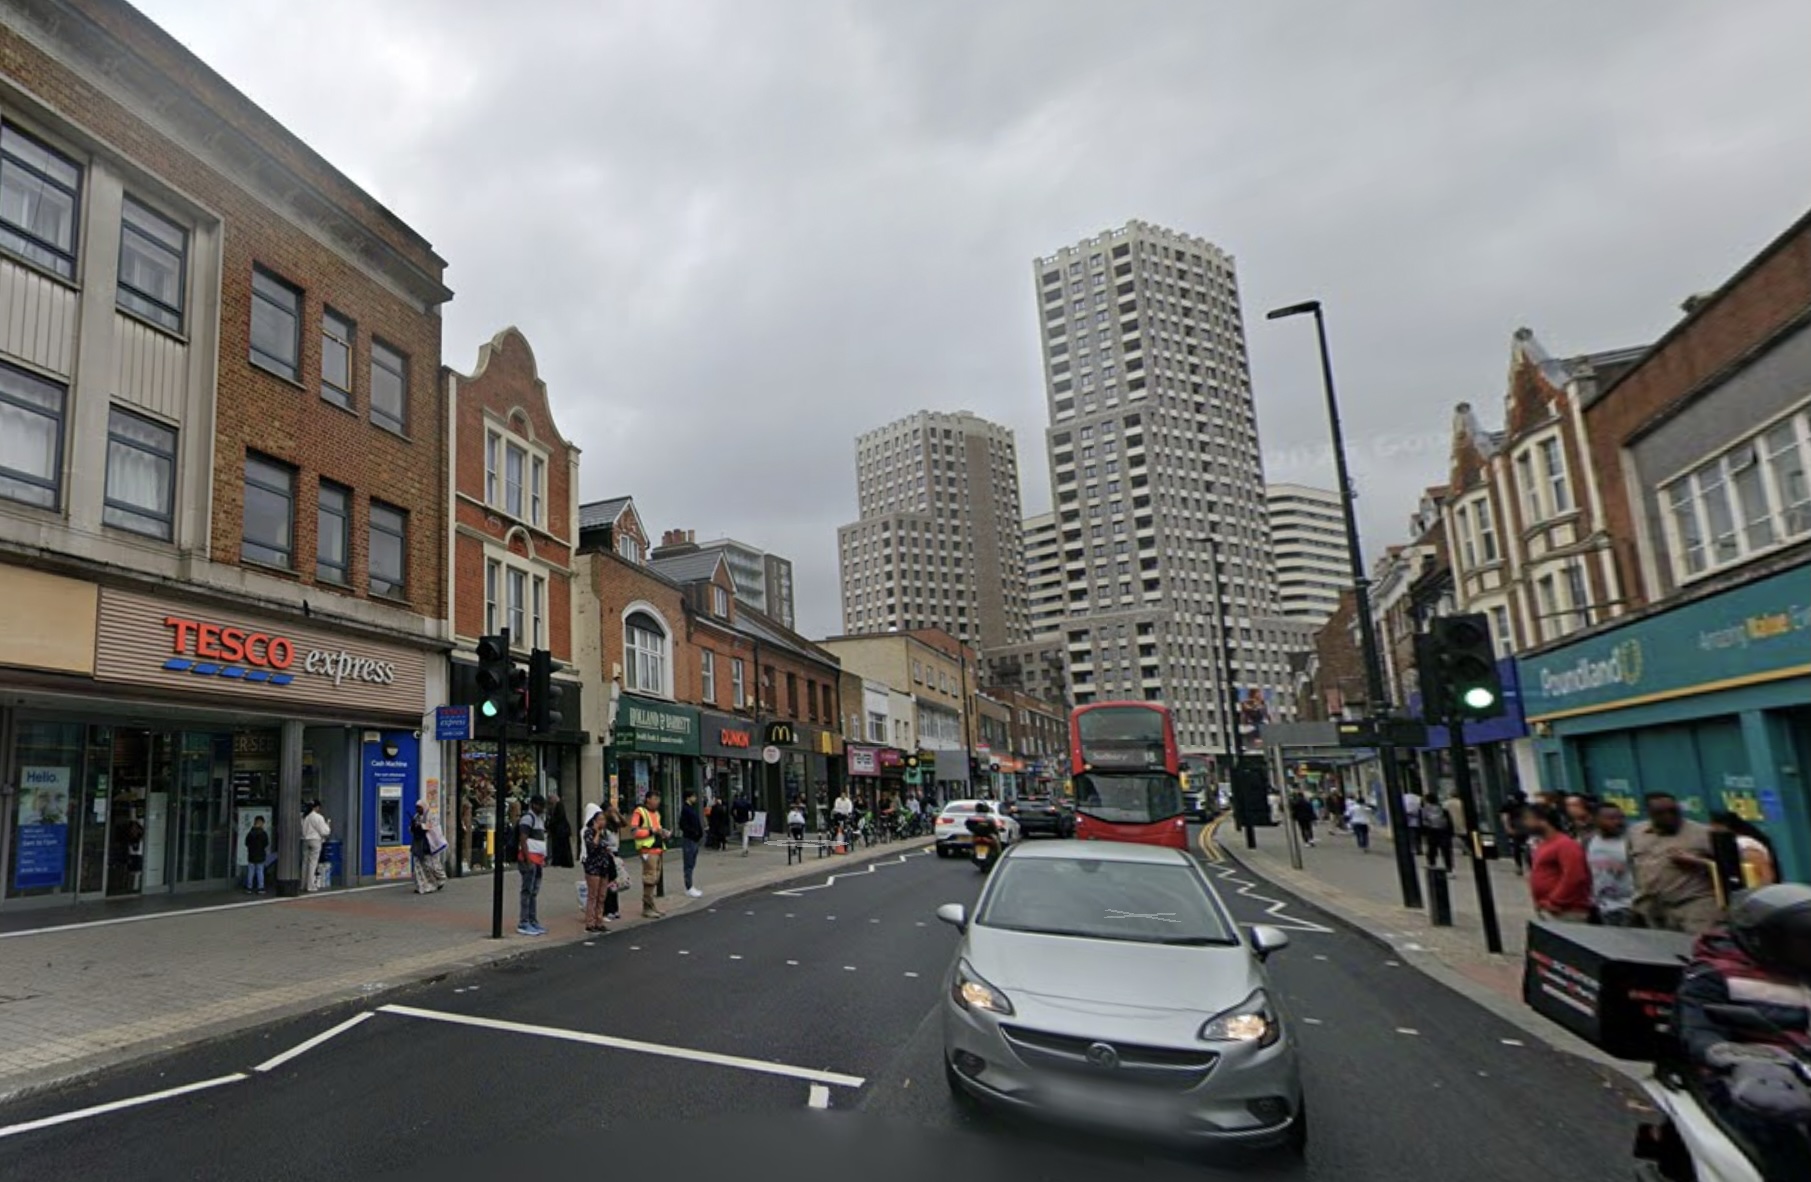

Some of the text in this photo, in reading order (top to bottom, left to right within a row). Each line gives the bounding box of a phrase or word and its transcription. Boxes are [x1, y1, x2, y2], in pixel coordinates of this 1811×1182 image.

[165, 616, 395, 687] TESCO express
[1541, 648, 1621, 697] Poundland
[371, 759, 408, 768] Cash Machine
